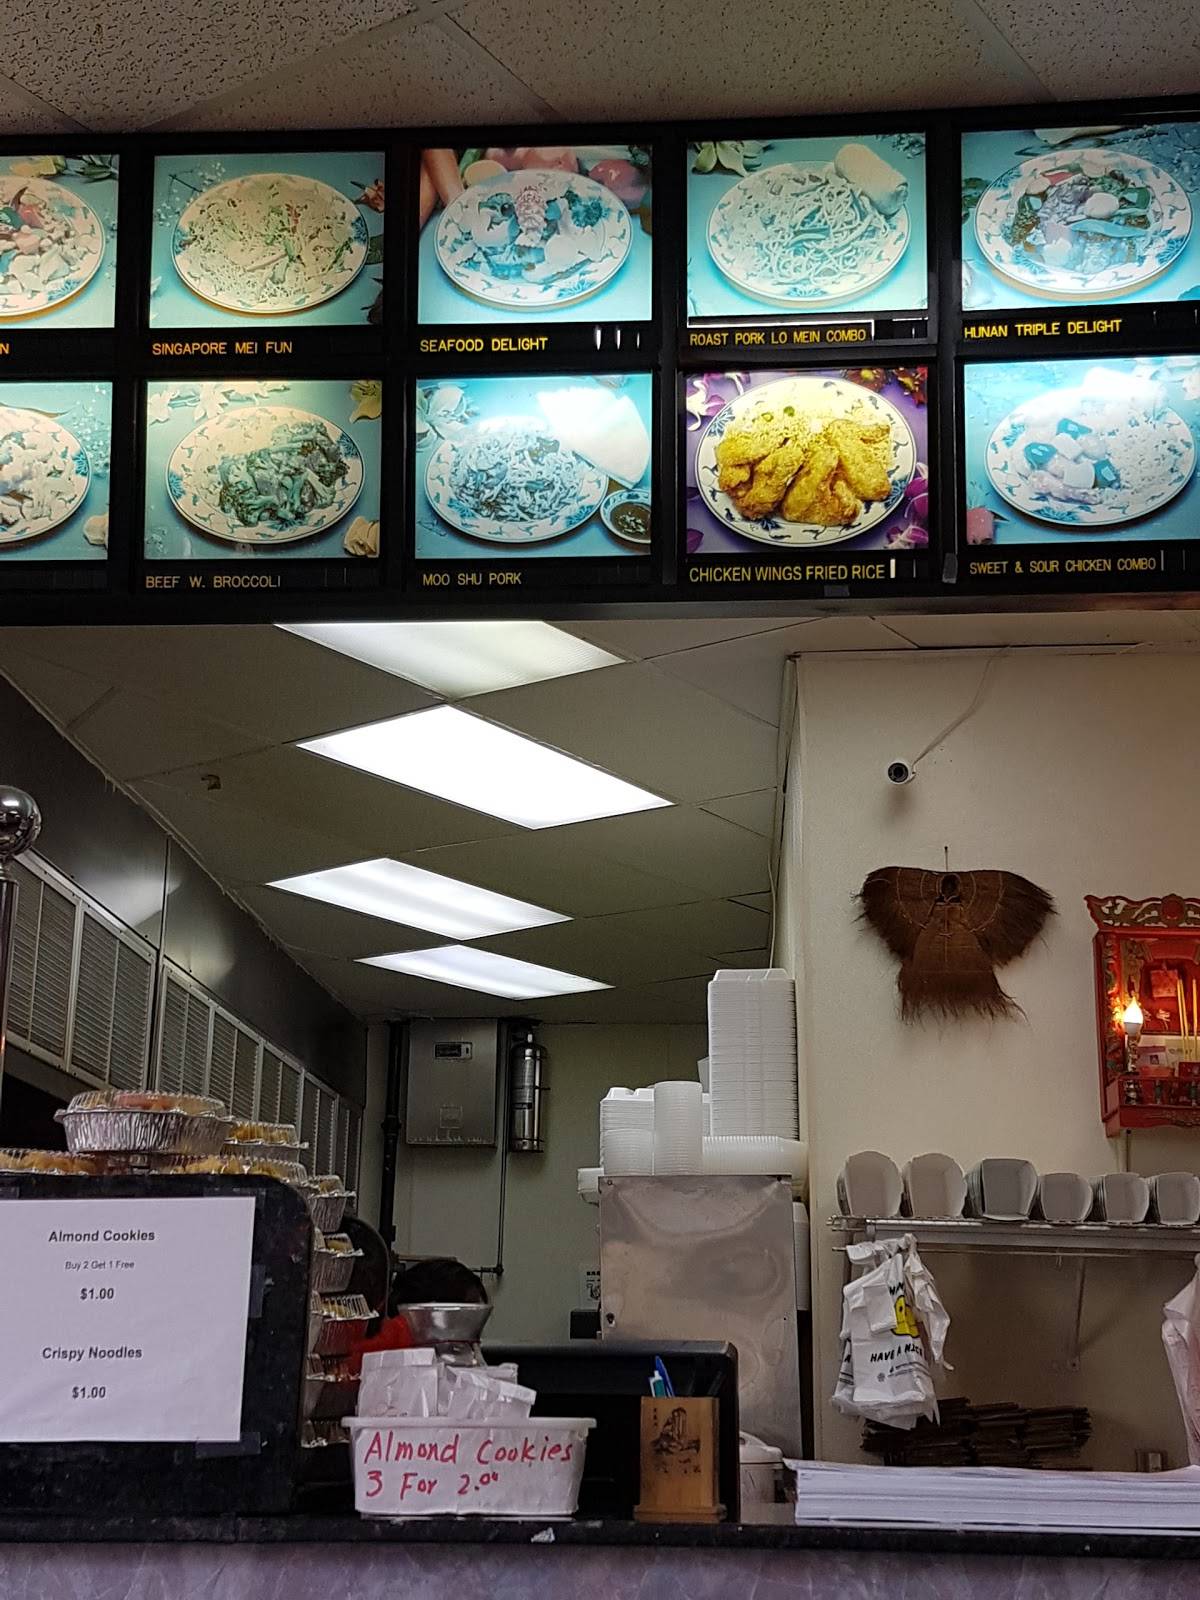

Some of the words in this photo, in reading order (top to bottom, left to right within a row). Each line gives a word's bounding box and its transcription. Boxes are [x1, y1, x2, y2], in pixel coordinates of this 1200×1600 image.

[964, 324, 1008, 339] HUNAN
[1015, 322, 1061, 337] TRIPLE
[1067, 319, 1123, 335] DELIGHT
[420, 338, 485, 353] SEAFOOD
[491, 337, 549, 352] DELIGHT
[689, 332, 729, 346] ROAST
[734, 331, 765, 345] PORK
[771, 331, 788, 345] LO
[793, 330, 821, 344] MEIN
[826, 329, 867, 343] COMBO
[152, 342, 228, 356] SINGAPORE
[235, 342, 259, 354] MEI
[265, 341, 293, 354] FUN
[689, 566, 751, 582] CHICKEN
[755, 566, 802, 582] WINGS
[806, 565, 848, 580] FRIED
[851, 564, 885, 579] RICE
[970, 561, 1008, 575] SWEET
[1015, 561, 1023, 574] &
[1030, 560, 1060, 573] SOUR
[1065, 558, 1112, 572] CHICKEN
[1117, 557, 1156, 571] COMBO
[145, 575, 180, 589] BEEF
[190, 576, 206, 588] W.
[213, 575, 281, 588] BROCCOLI
[423, 573, 450, 586] MOO
[457, 573, 482, 586] SHU
[489, 572, 522, 585] PORK
[48, 1229, 100, 1243] Almond
[103, 1229, 156, 1242] Cookies
[64, 1260, 82, 1271] Buy
[83, 1260, 89, 1270] 2
[91, 1260, 106, 1270] Get
[115, 1260, 135, 1269] Free
[79, 1287, 115, 1301] $1.00
[42, 1347, 85, 1361] Crispy
[88, 1346, 143, 1360] Noodles
[870, 1350, 895, 1362] HAVE
[71, 1386, 106, 1400] $1.00
[364, 1431, 458, 1465] Almond
[476, 1436, 573, 1467] Cookies
[365, 1470, 383, 1498] 3
[400, 1472, 438, 1499] For
